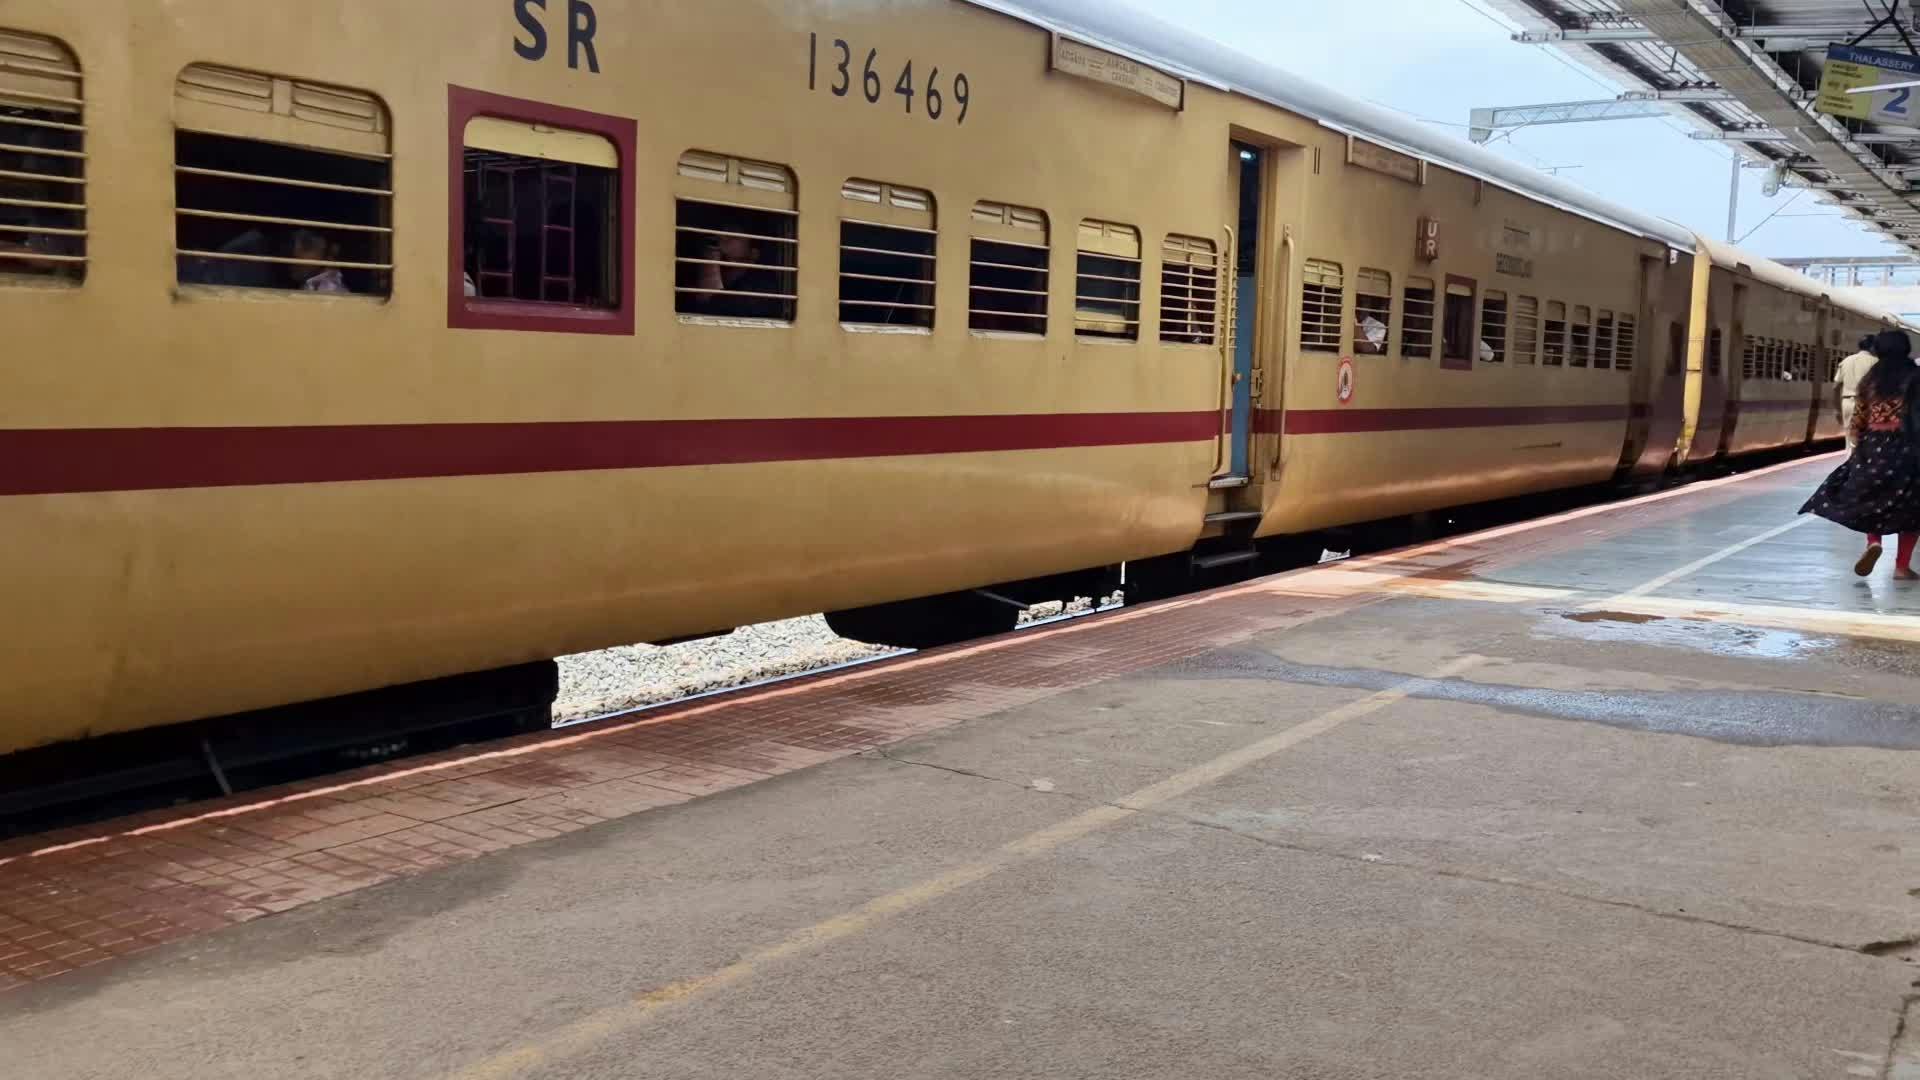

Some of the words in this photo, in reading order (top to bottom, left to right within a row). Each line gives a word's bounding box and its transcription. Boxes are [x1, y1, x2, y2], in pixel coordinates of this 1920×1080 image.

[1849, 53, 1915, 71] THALASSERY
[809, 32, 969, 124] 136469
[1883, 86, 1910, 113] 2
